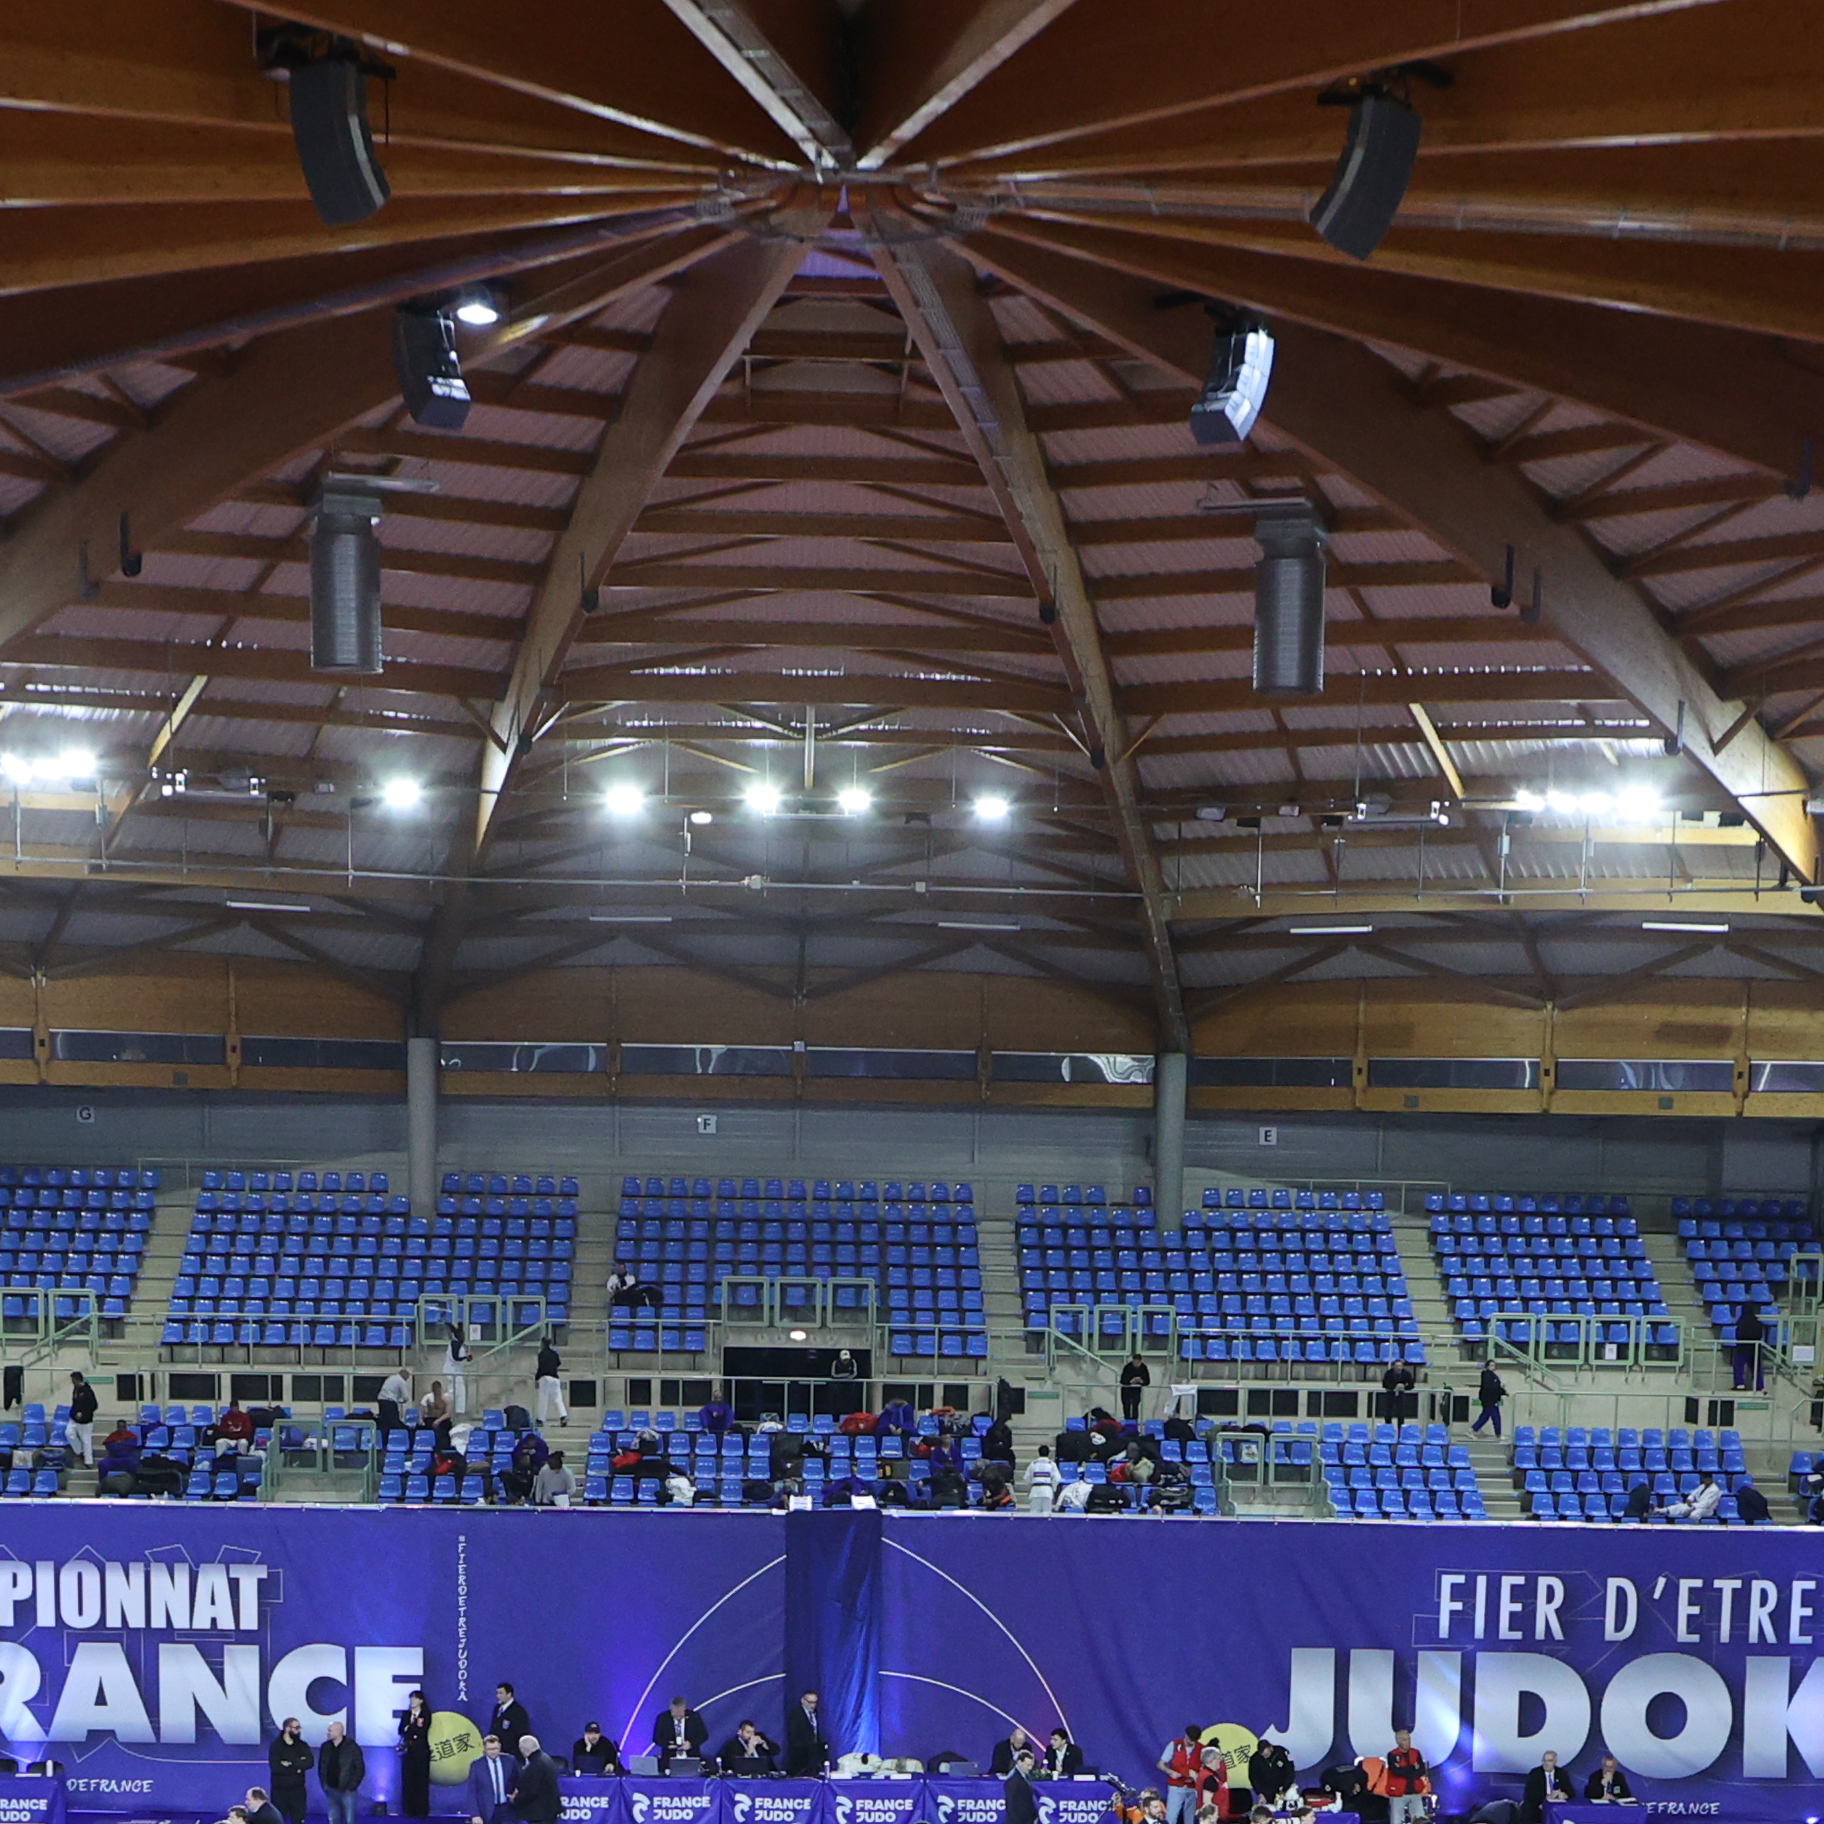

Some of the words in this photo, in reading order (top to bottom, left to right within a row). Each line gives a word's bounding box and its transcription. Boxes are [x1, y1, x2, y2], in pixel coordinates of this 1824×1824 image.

[79, 1107, 92, 1121] G
[703, 1118, 712, 1131] F
[1264, 1130, 1272, 1143] E
[1439, 1573, 1566, 1641] FIER
[1605, 1576, 1818, 1645] D'ETRE
[653, 1796, 712, 1809] FRANCE
[753, 1797, 812, 1811] FRANCE
[855, 1799, 915, 1812] FRANCE
[957, 1800, 1007, 1812] FRANC
[653, 1809, 695, 1821] JUDO
[753, 1810, 796, 1823] JUDO
[855, 1811, 897, 1824] JUDO
[957, 1812, 999, 1824] JUDO
